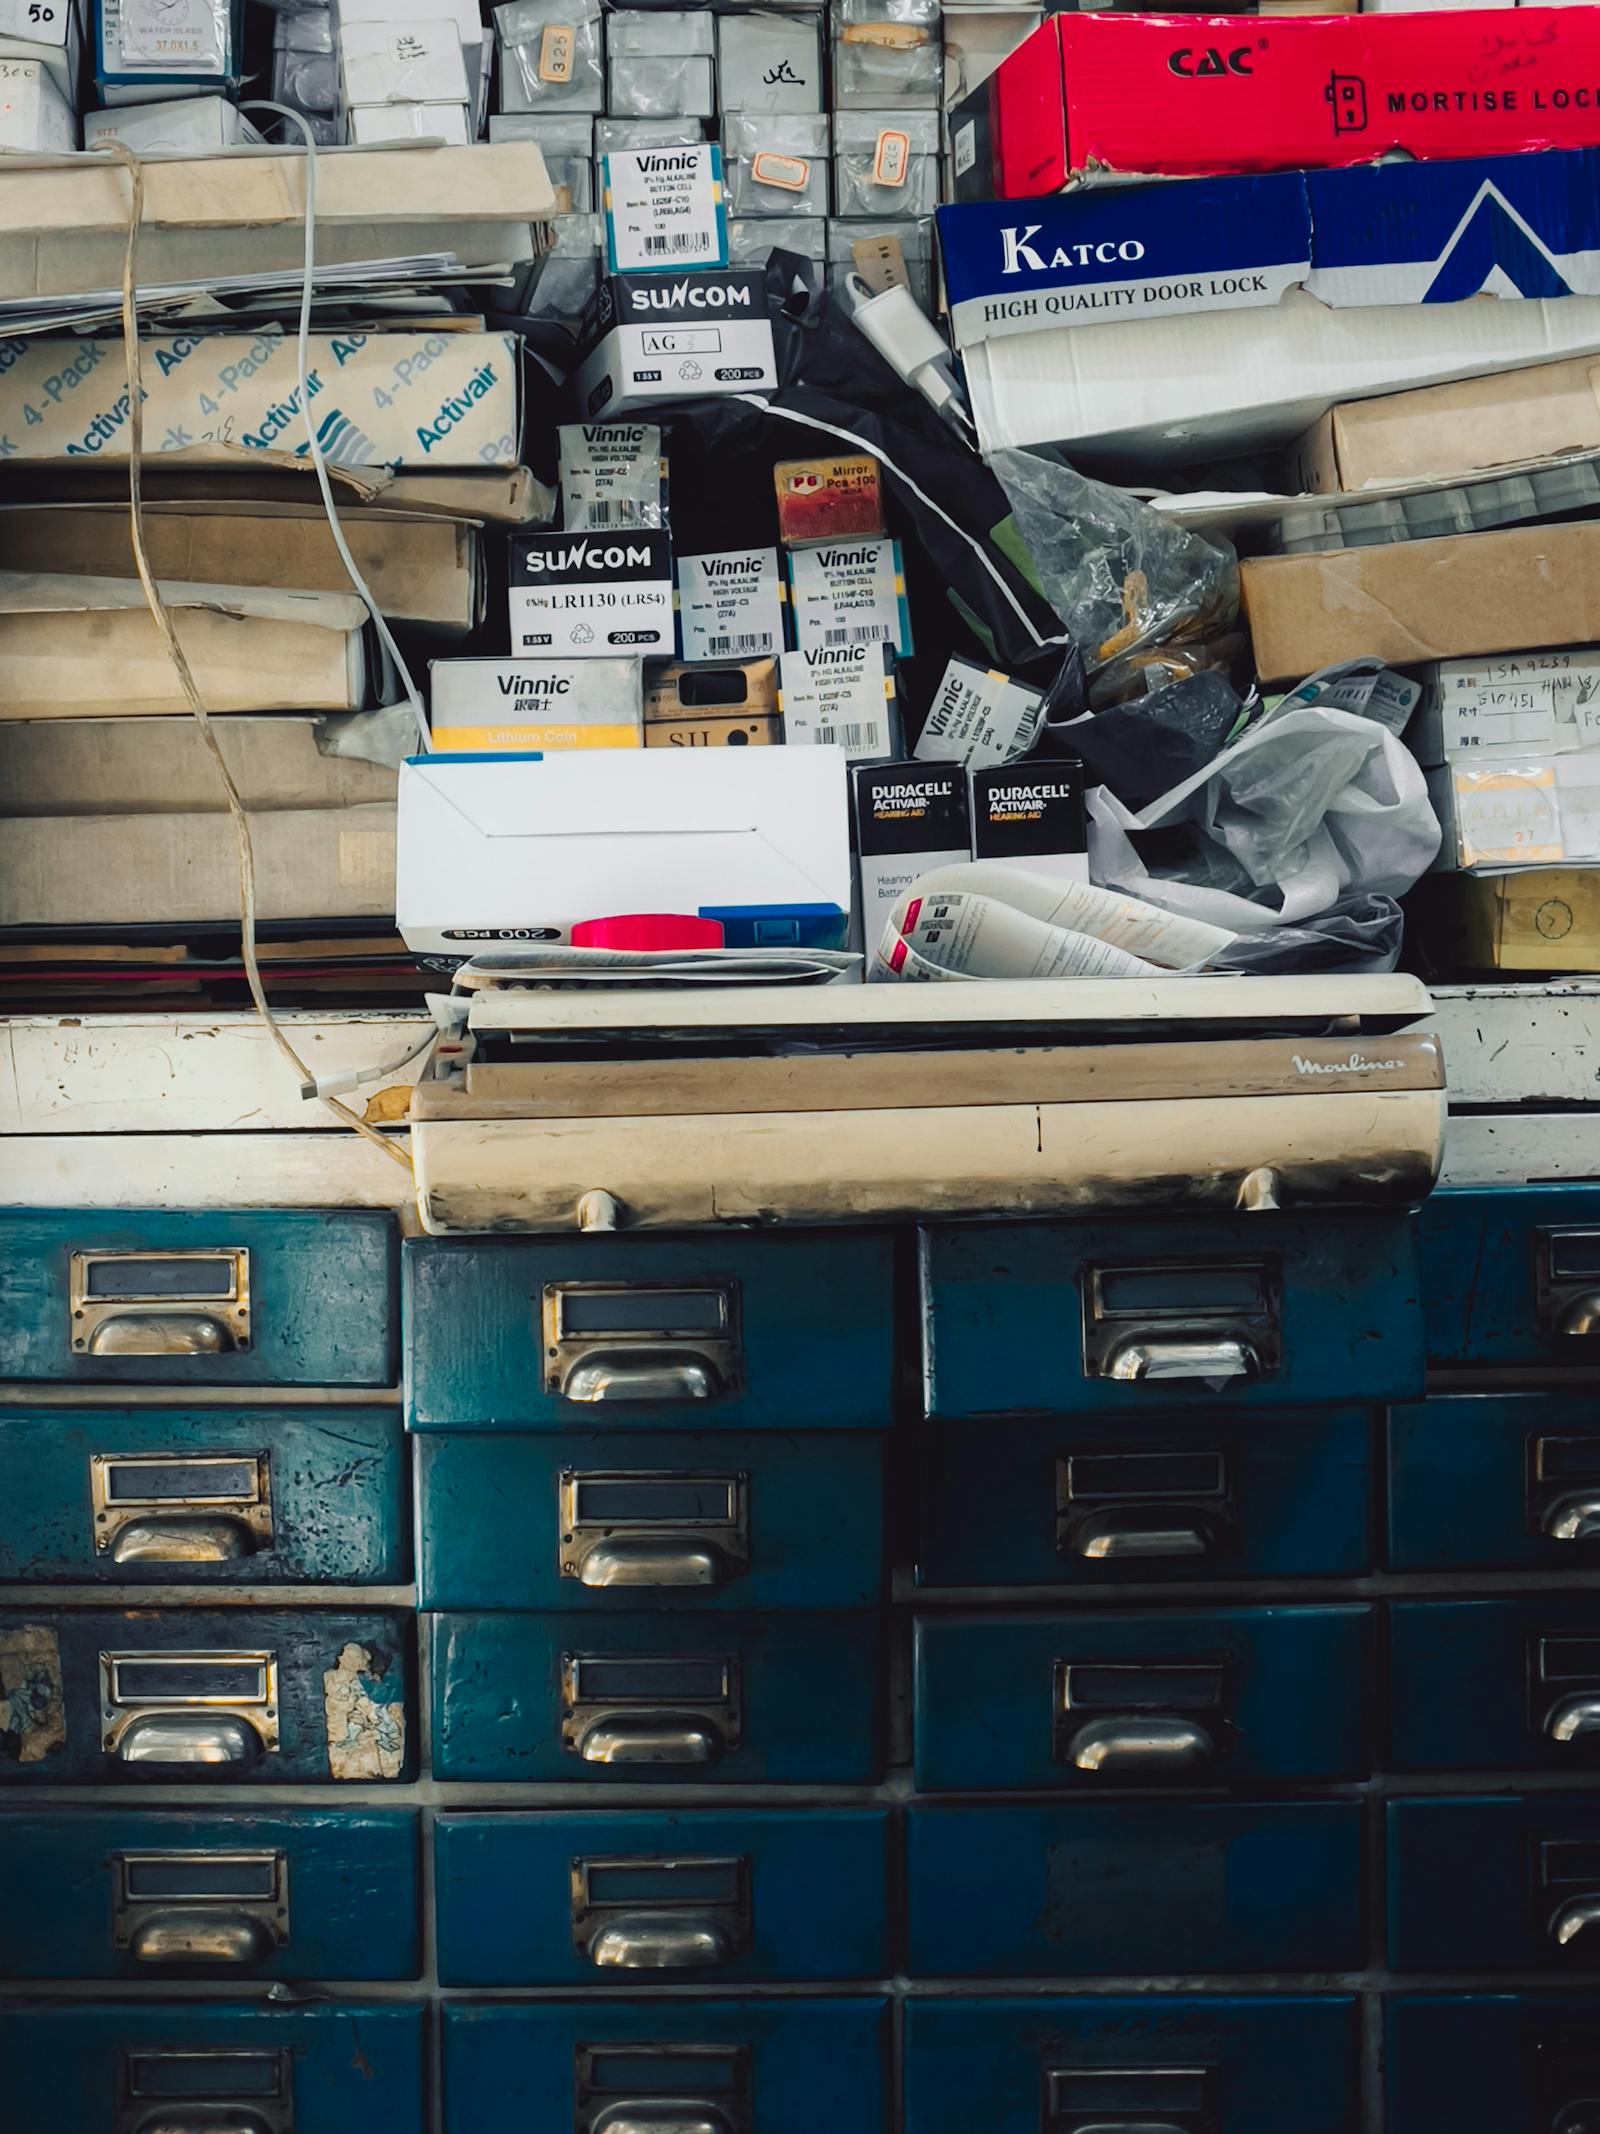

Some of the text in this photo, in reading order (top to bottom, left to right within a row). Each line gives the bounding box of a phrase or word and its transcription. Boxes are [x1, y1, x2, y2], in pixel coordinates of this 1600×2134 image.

[28, 4, 54, 22] 50
[139, 27, 171, 35] WATCH
[552, 35, 568, 73] 325
[1167, 47, 1253, 78] CAC
[1387, 90, 1518, 113] MORTISE
[636, 153, 698, 173] Vinnic
[666, 173, 697, 182] ALKALINE
[650, 183, 692, 193] BUTTON CELL
[984, 275, 1268, 322] HIGH QUALITY DOOR LOCK
[648, 335, 676, 351] AG
[198, 335, 284, 417] 4-Pack
[720, 369, 761, 380] 200 PCS
[22, 340, 106, 426] 4-Pack
[416, 362, 499, 453] Activair
[582, 426, 644, 443] Vinnic
[610, 445, 642, 453] ALKALINE
[832, 466, 868, 476] Mirror
[816, 547, 878, 568] Vinnic
[701, 557, 763, 576] Vinnic
[846, 567, 876, 576] ALKALINE
[729, 577, 760, 585] ALKALINE
[830, 579, 856, 587] BUTTON
[713, 586, 758, 596] HIGH VOLTAGE
[551, 593, 616, 609] LR1130
[621, 593, 666, 607] (LR54)
[613, 633, 636, 643] 200
[804, 645, 866, 666] Vinnic
[834, 665, 864, 675] ALKALINE
[1526, 656, 1570, 672] 9239
[497, 675, 570, 695] Vinnic
[815, 676, 861, 687] HIGH VOLTAGE
[819, 703, 838, 713] (27A)
[926, 679, 964, 737] Vinnic
[966, 694, 982, 722] VOLTAGE
[488, 731, 577, 744] Lithium Coin
[871, 783, 952, 800] DURACELL
[988, 785, 1070, 801] DURACELL
[873, 797, 930, 811] ACTIVAIR
[990, 800, 1047, 813] ACTIVAIR
[874, 809, 926, 819] HEARING AID
[989, 811, 1041, 822] HEARING AID
[877, 874, 913, 886] Hearing
[452, 928, 547, 940] 200 PCS
